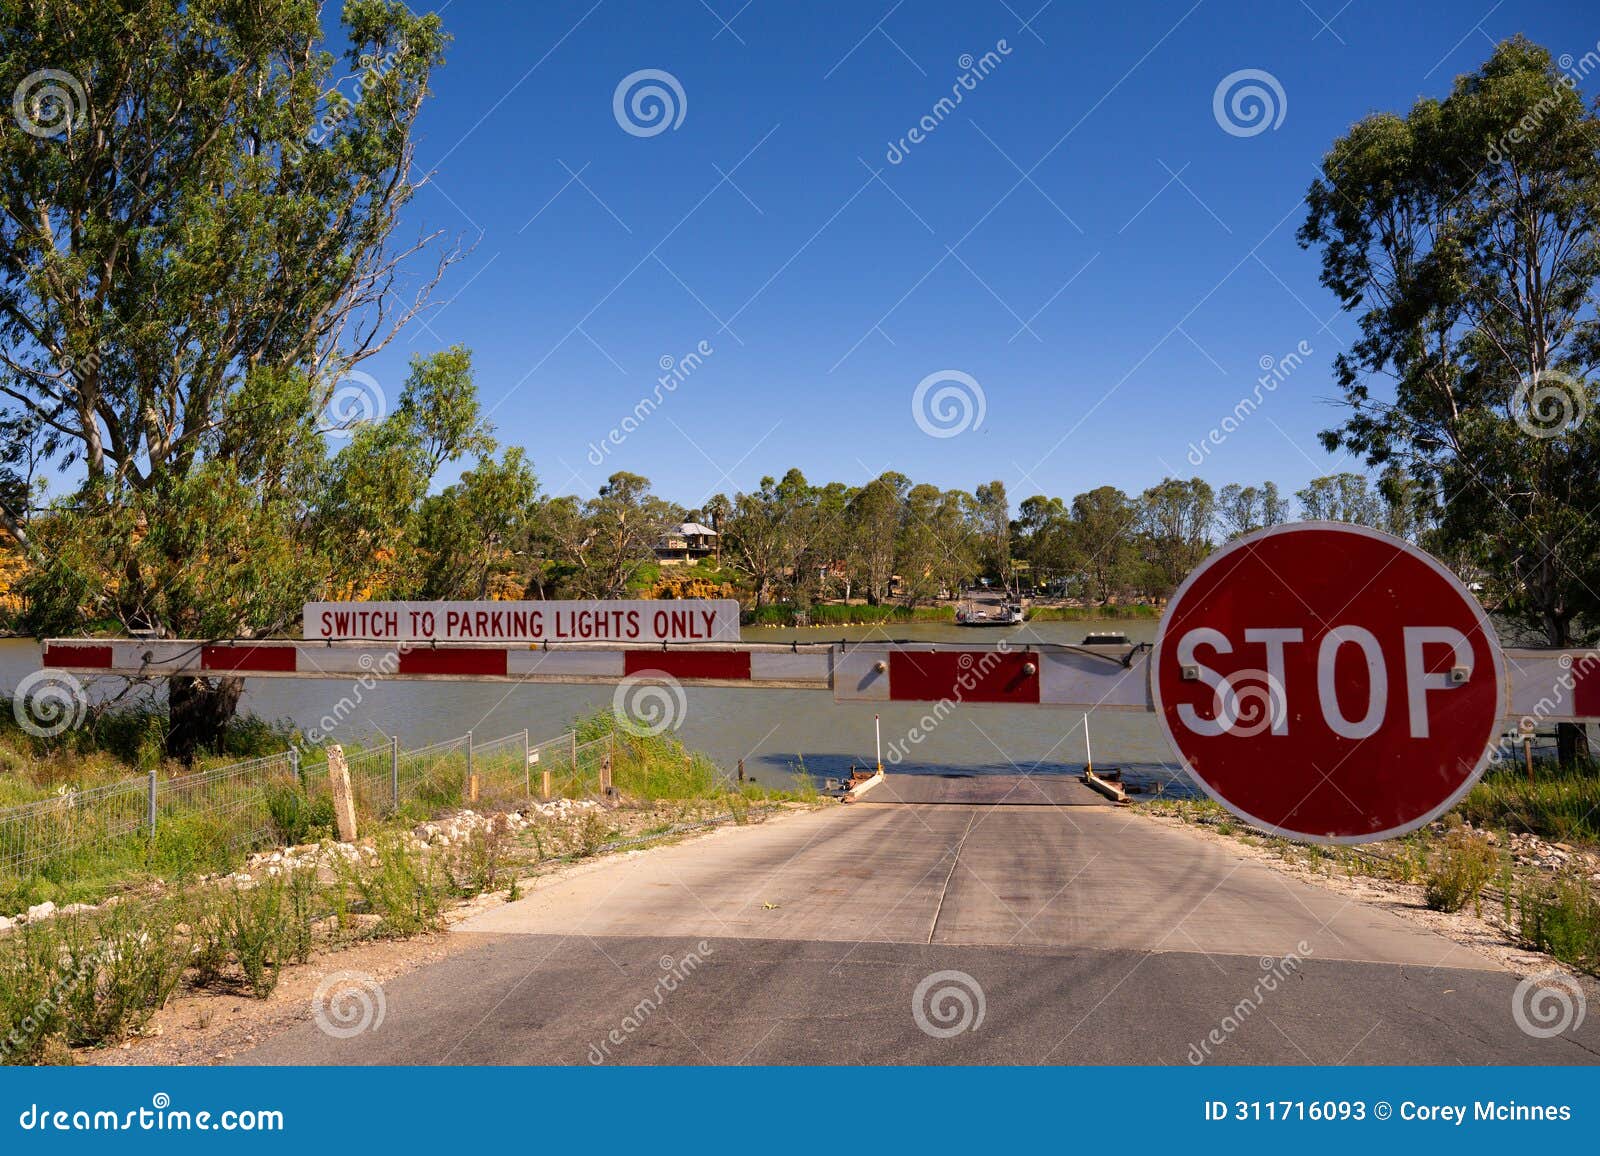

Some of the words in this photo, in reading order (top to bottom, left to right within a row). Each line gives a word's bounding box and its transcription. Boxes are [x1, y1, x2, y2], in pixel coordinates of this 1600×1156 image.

[321, 611, 398, 637] SWITCH
[410, 611, 435, 637] TO
[447, 611, 543, 638] PARKING
[556, 611, 640, 638] LIGHTS
[653, 611, 717, 639] ONLY
[1176, 625, 1476, 739] STOP
